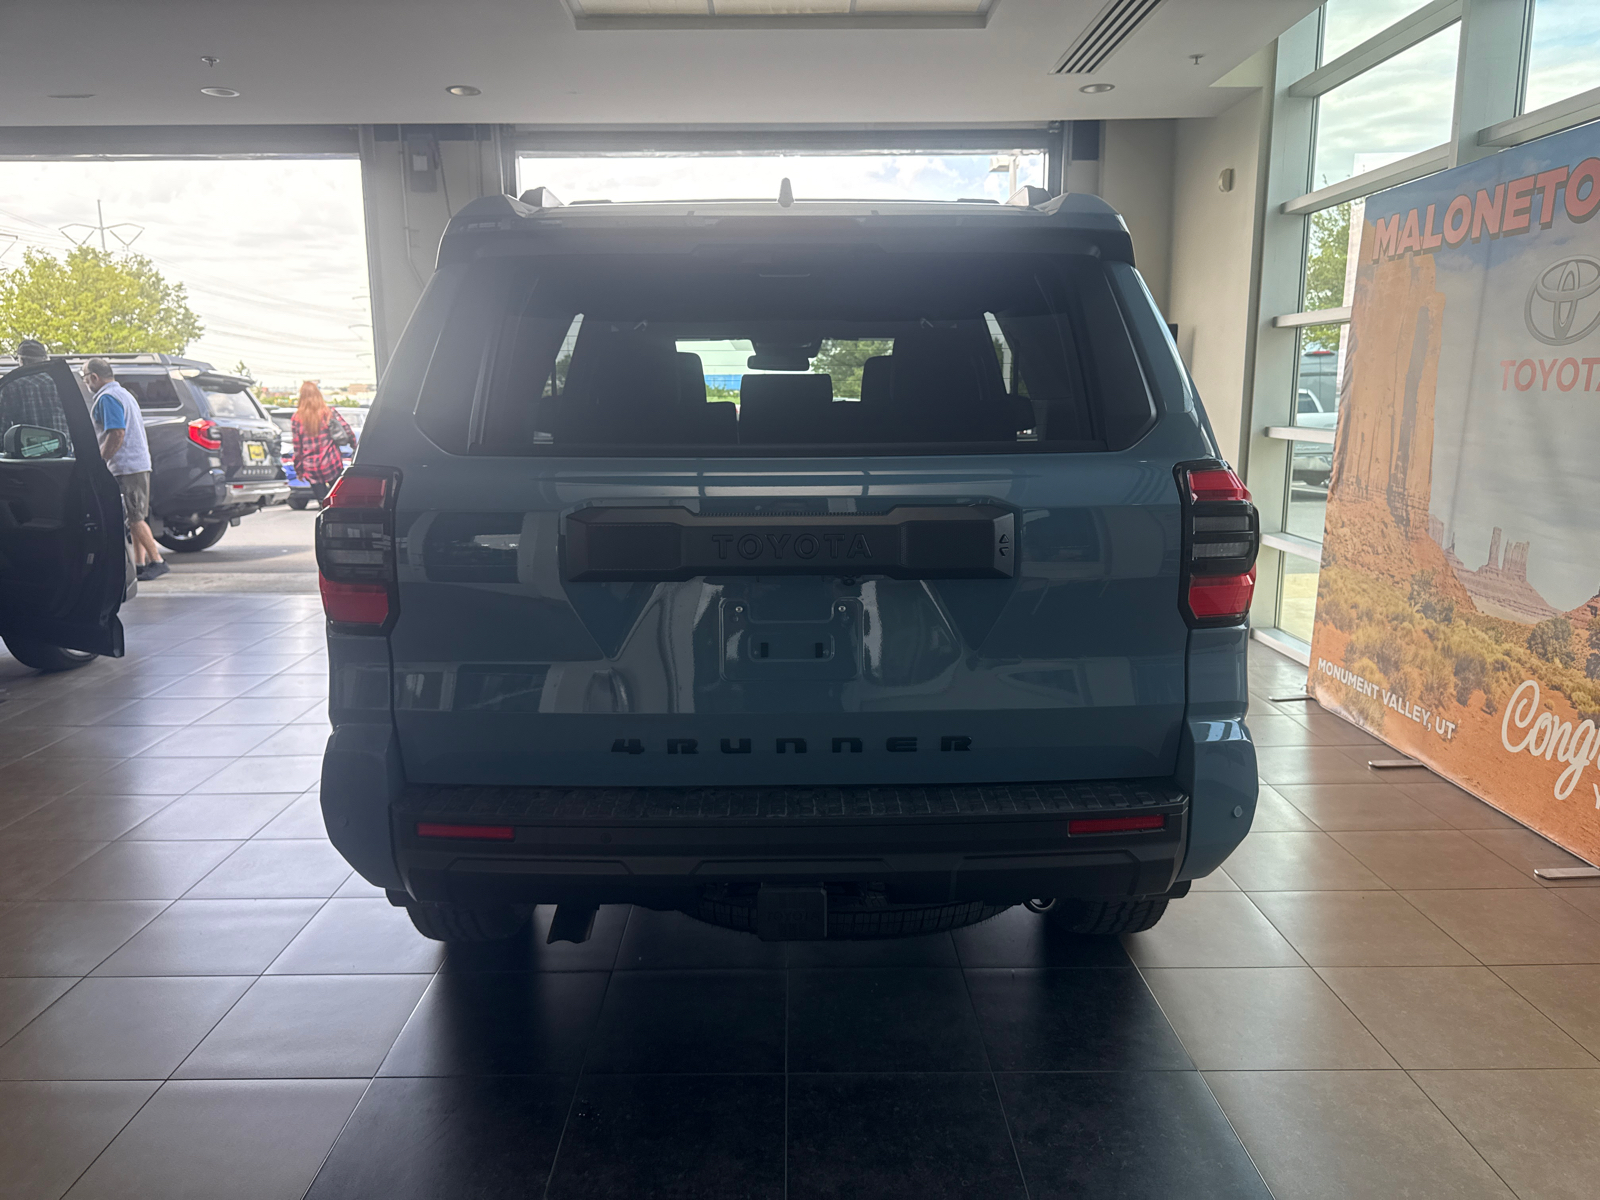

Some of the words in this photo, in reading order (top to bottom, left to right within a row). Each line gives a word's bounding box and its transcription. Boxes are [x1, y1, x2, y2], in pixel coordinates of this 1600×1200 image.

[1500, 356, 1600, 393] TOYOT
[711, 533, 873, 560] TOYOTA
[1317, 657, 1379, 700] MONUMENT
[1382, 689, 1431, 731] VALLEY,
[1435, 716, 1456, 740] UT
[610, 735, 973, 755] 4RUNNER
